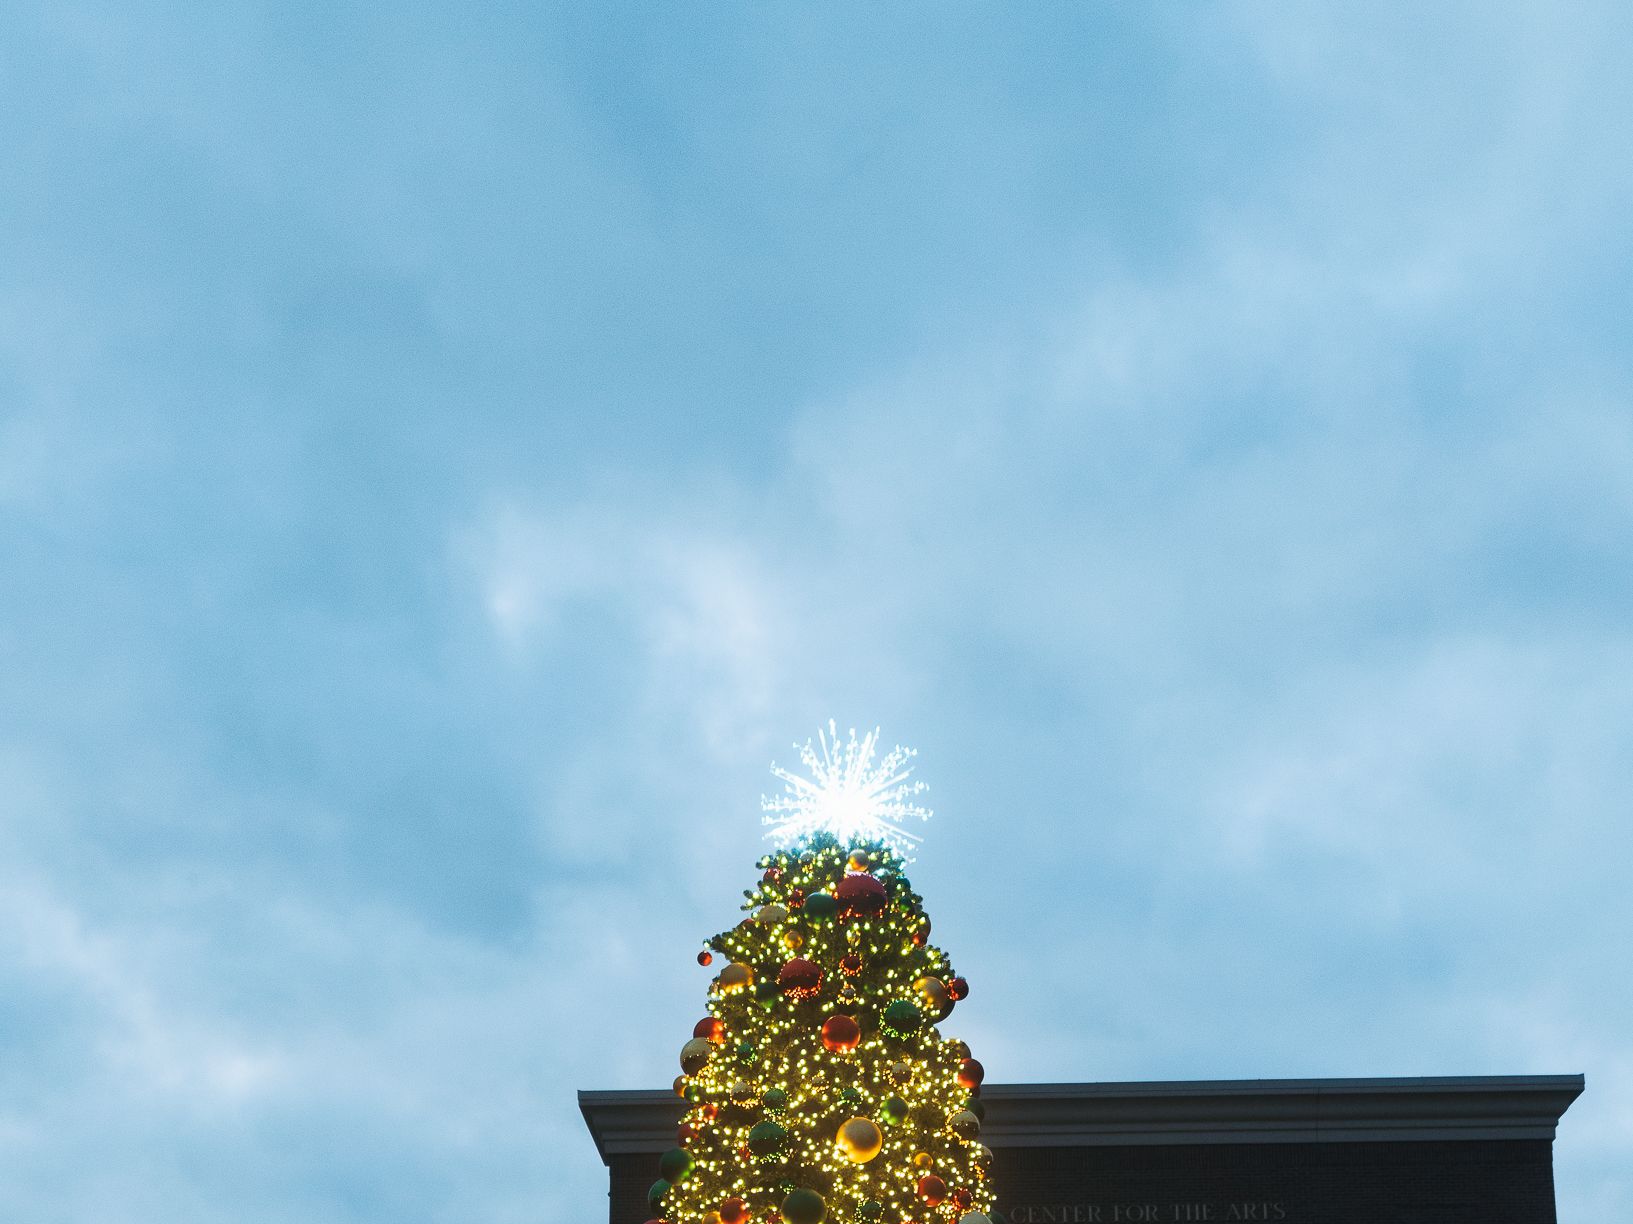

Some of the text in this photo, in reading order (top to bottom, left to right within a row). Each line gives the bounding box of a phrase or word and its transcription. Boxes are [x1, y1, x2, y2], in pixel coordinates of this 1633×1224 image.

[1010, 1202, 1287, 1224] CENTER FOR THE ARTS
